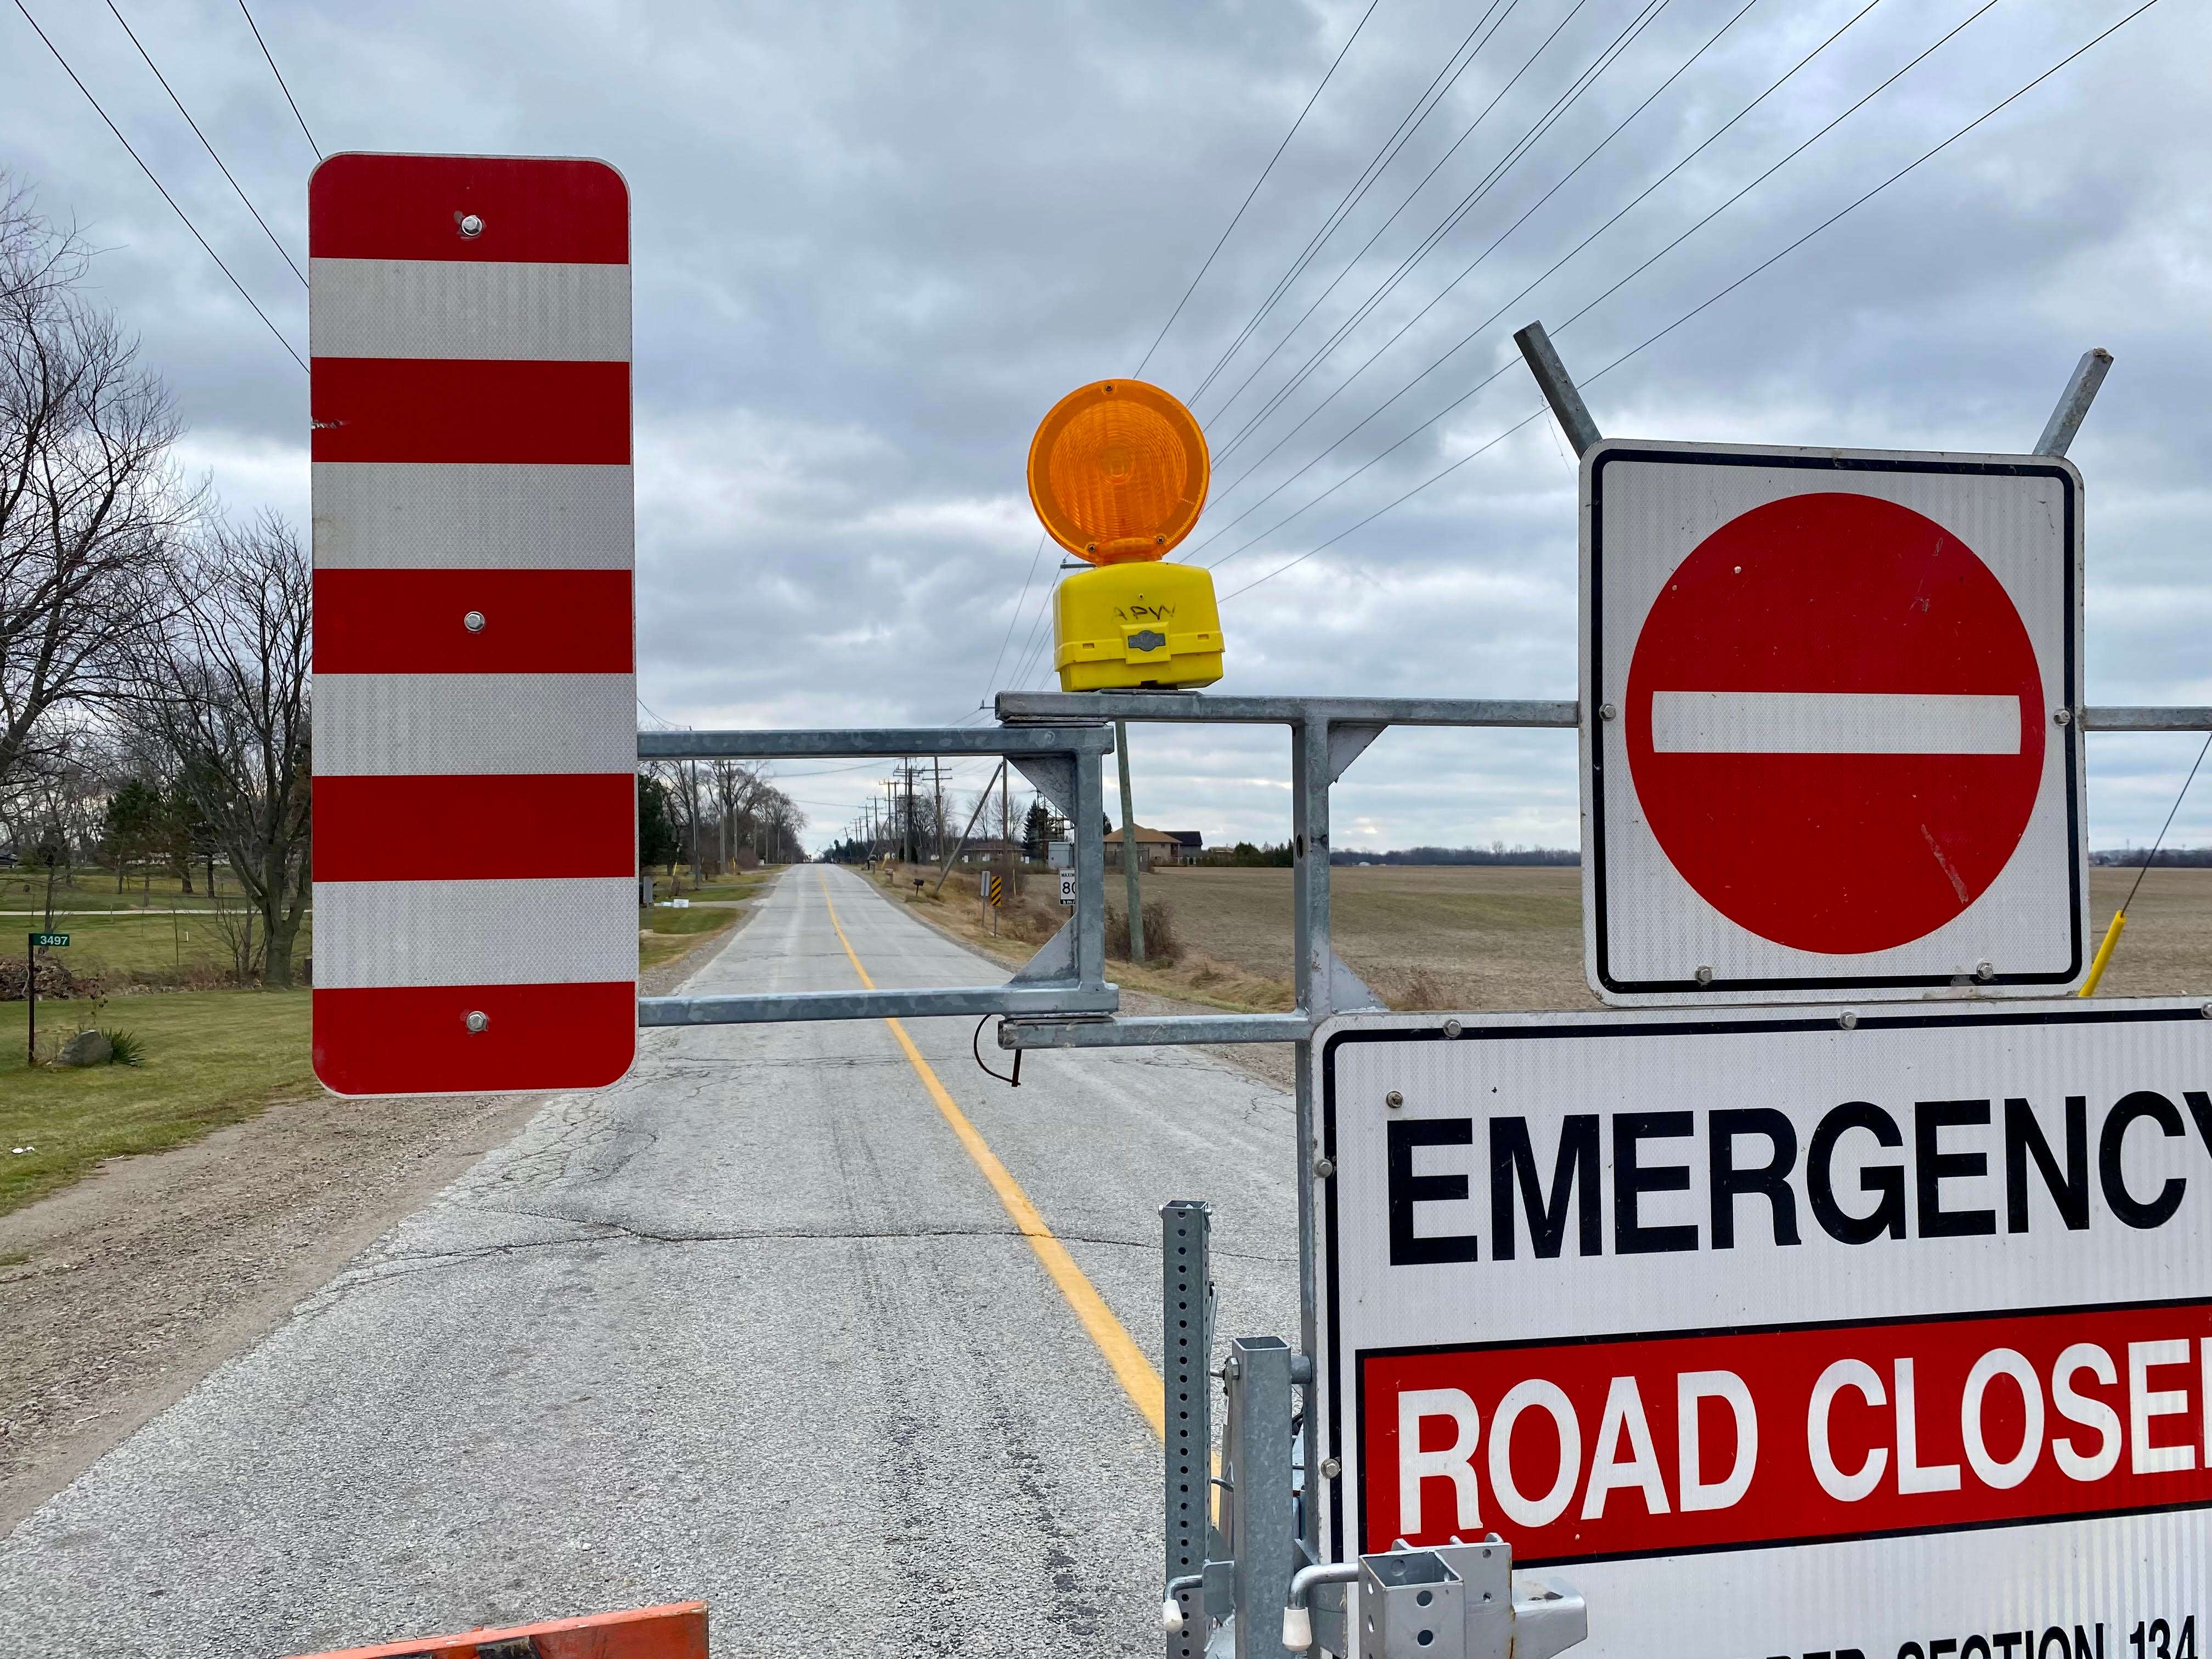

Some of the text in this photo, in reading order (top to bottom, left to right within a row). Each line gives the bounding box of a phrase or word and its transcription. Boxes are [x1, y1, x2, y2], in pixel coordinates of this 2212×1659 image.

[1111, 602, 1176, 622] APW
[40, 935, 68, 945] 3497
[1398, 1336, 2212, 1535] ROAD CLOSE
[2130, 1615, 2198, 1659] 134
